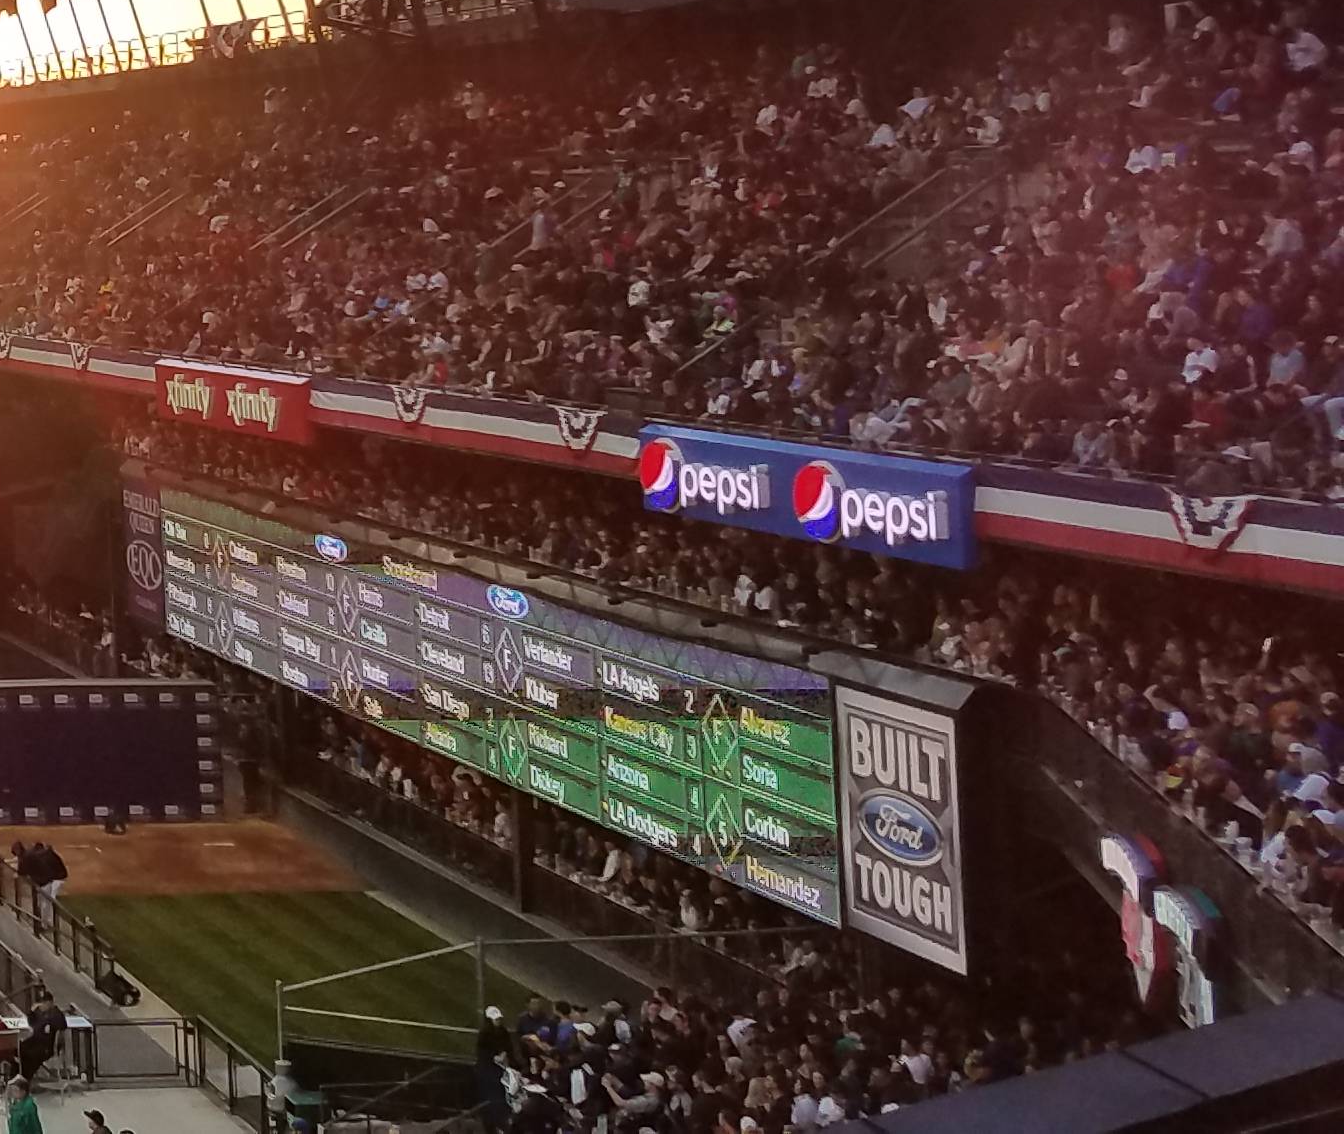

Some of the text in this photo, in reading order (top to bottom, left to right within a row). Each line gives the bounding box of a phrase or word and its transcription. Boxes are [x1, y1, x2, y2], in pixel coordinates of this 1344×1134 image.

[166, 373, 211, 420] xfinity
[225, 382, 282, 433] xfinity
[680, 464, 762, 515] pepsi
[842, 490, 941, 546] pepsi
[602, 661, 620, 686] LA
[620, 669, 660, 702] Angels
[740, 705, 791, 747] Alvarez
[607, 753, 650, 791] Arizona
[742, 753, 779, 790] Soria
[850, 716, 945, 802] BUILT
[609, 797, 625, 822] LA
[625, 803, 678, 847] Dodgers
[717, 821, 727, 847] 5
[744, 808, 790, 848] Corbin
[875, 803, 923, 851] Ford
[745, 854, 822, 910] Hernandez
[855, 851, 952, 934] TOUGH
